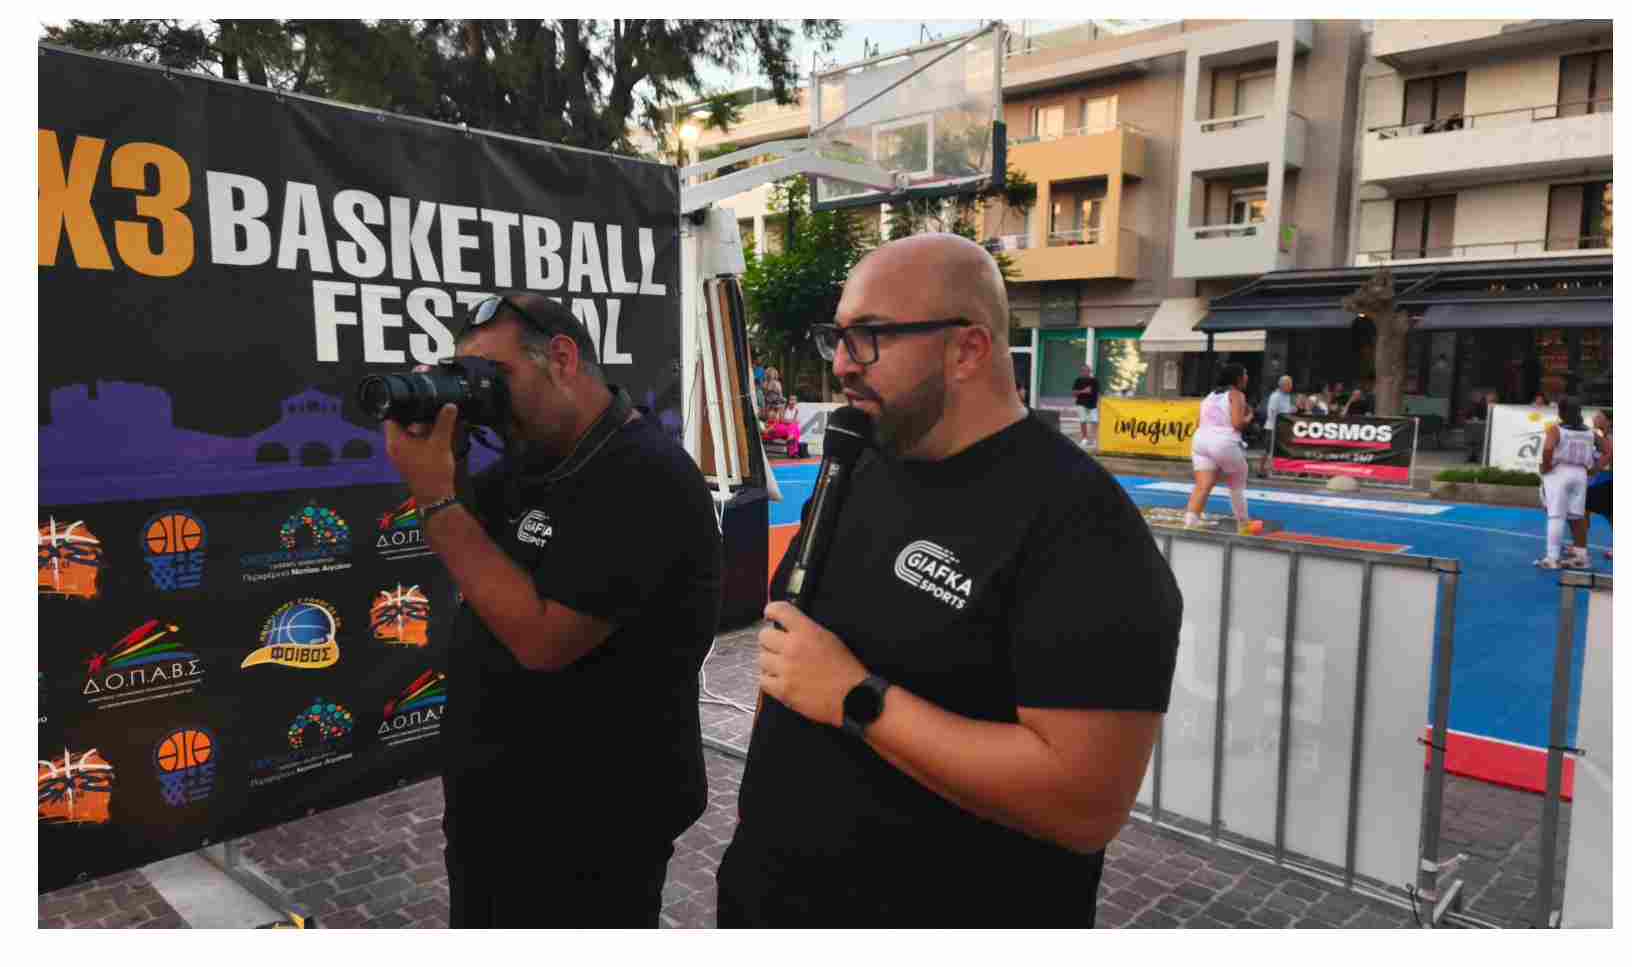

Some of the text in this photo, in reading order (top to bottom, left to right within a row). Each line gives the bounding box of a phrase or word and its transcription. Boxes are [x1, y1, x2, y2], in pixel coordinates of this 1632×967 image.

[206, 169, 667, 297] BASKETBALL
[1292, 421, 1393, 442] COSMOS
[907, 553, 973, 597] GIAFKA
[920, 578, 967, 609] SPORTS
[271, 647, 332, 663] ΦΟΙΒΟΣ
